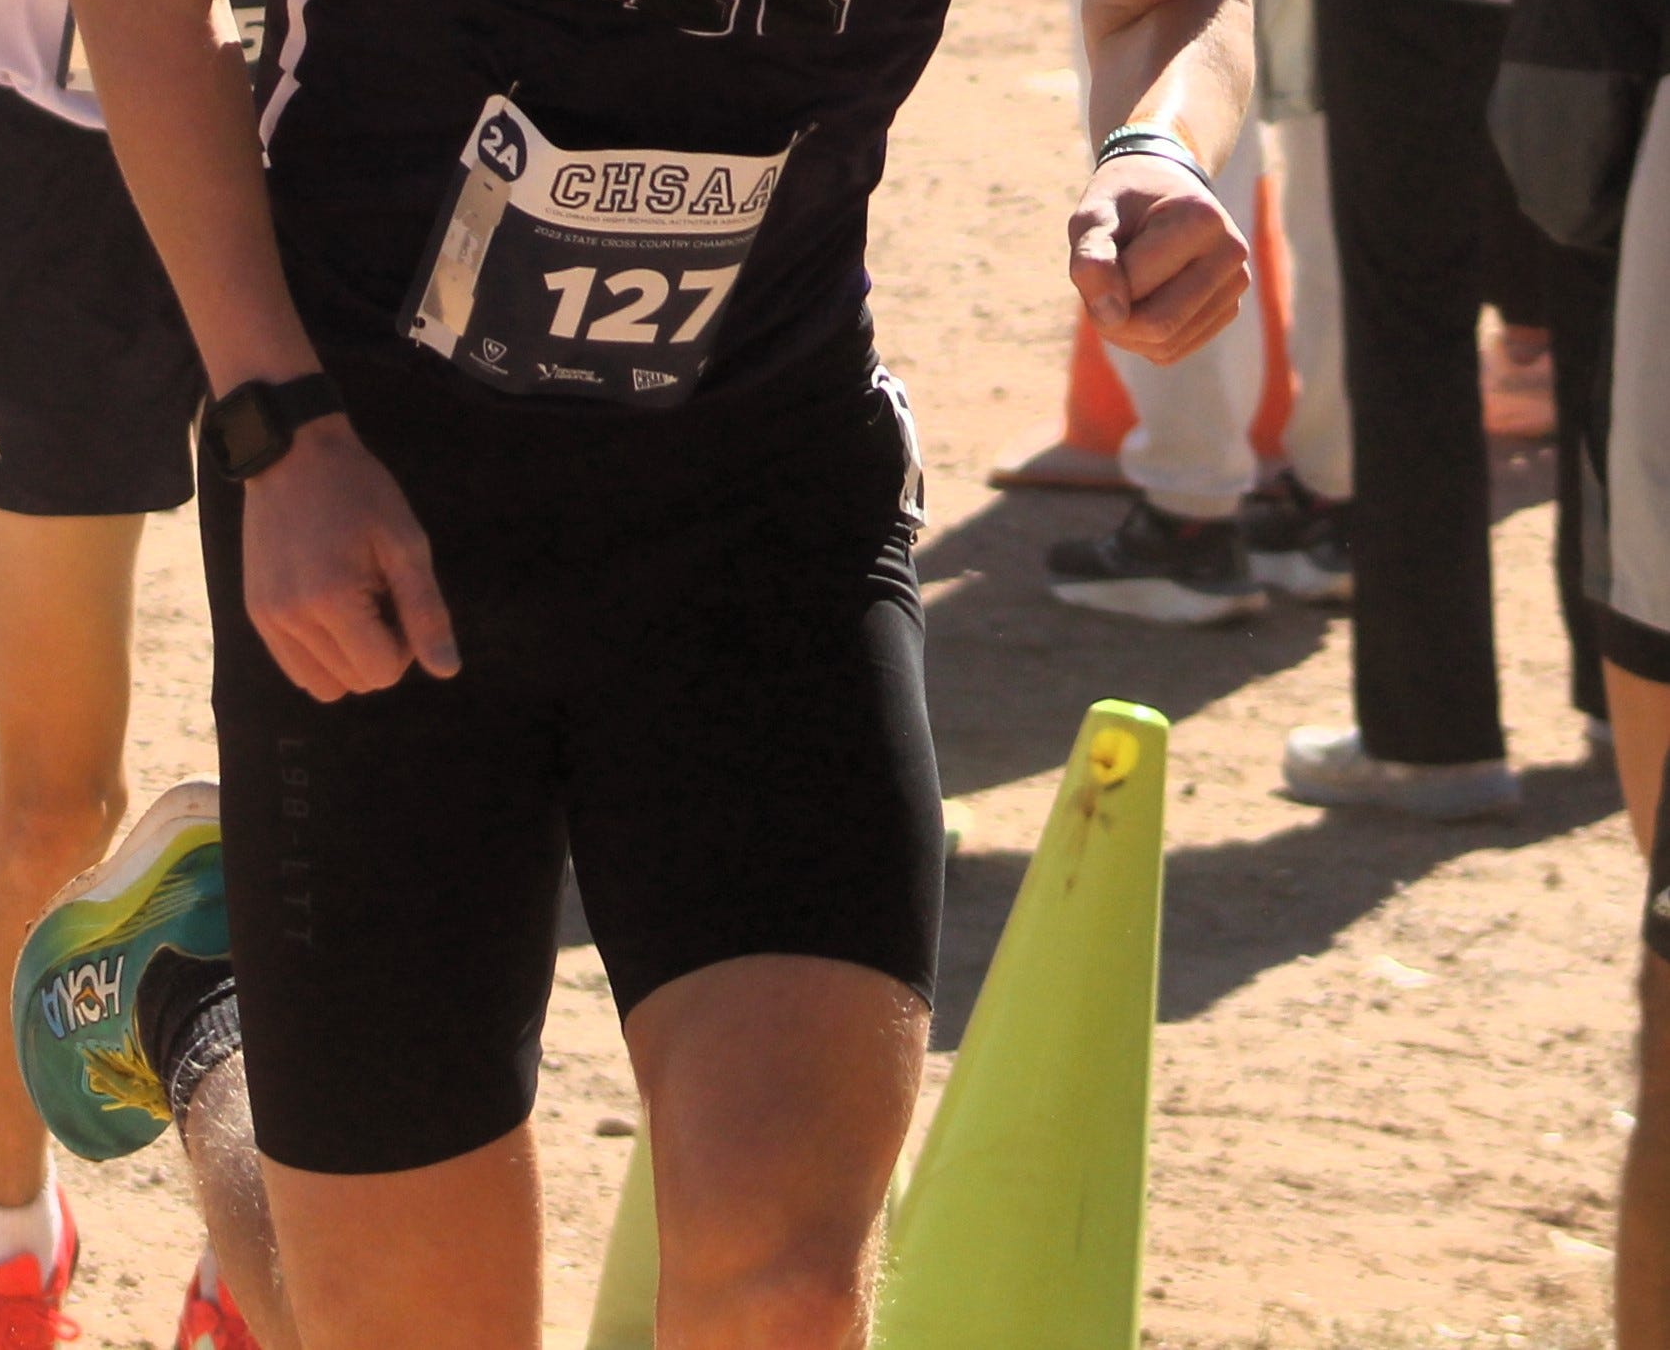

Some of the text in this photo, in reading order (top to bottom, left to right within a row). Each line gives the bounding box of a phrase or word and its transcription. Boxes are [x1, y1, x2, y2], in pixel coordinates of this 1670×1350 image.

[480, 126, 778, 215] 2A CHSAA
[534, 224, 562, 240] 2023
[563, 233, 598, 247] STATE
[601, 237, 637, 249] CROSS
[639, 238, 689, 249] COUNTRY
[543, 262, 742, 344] 127
